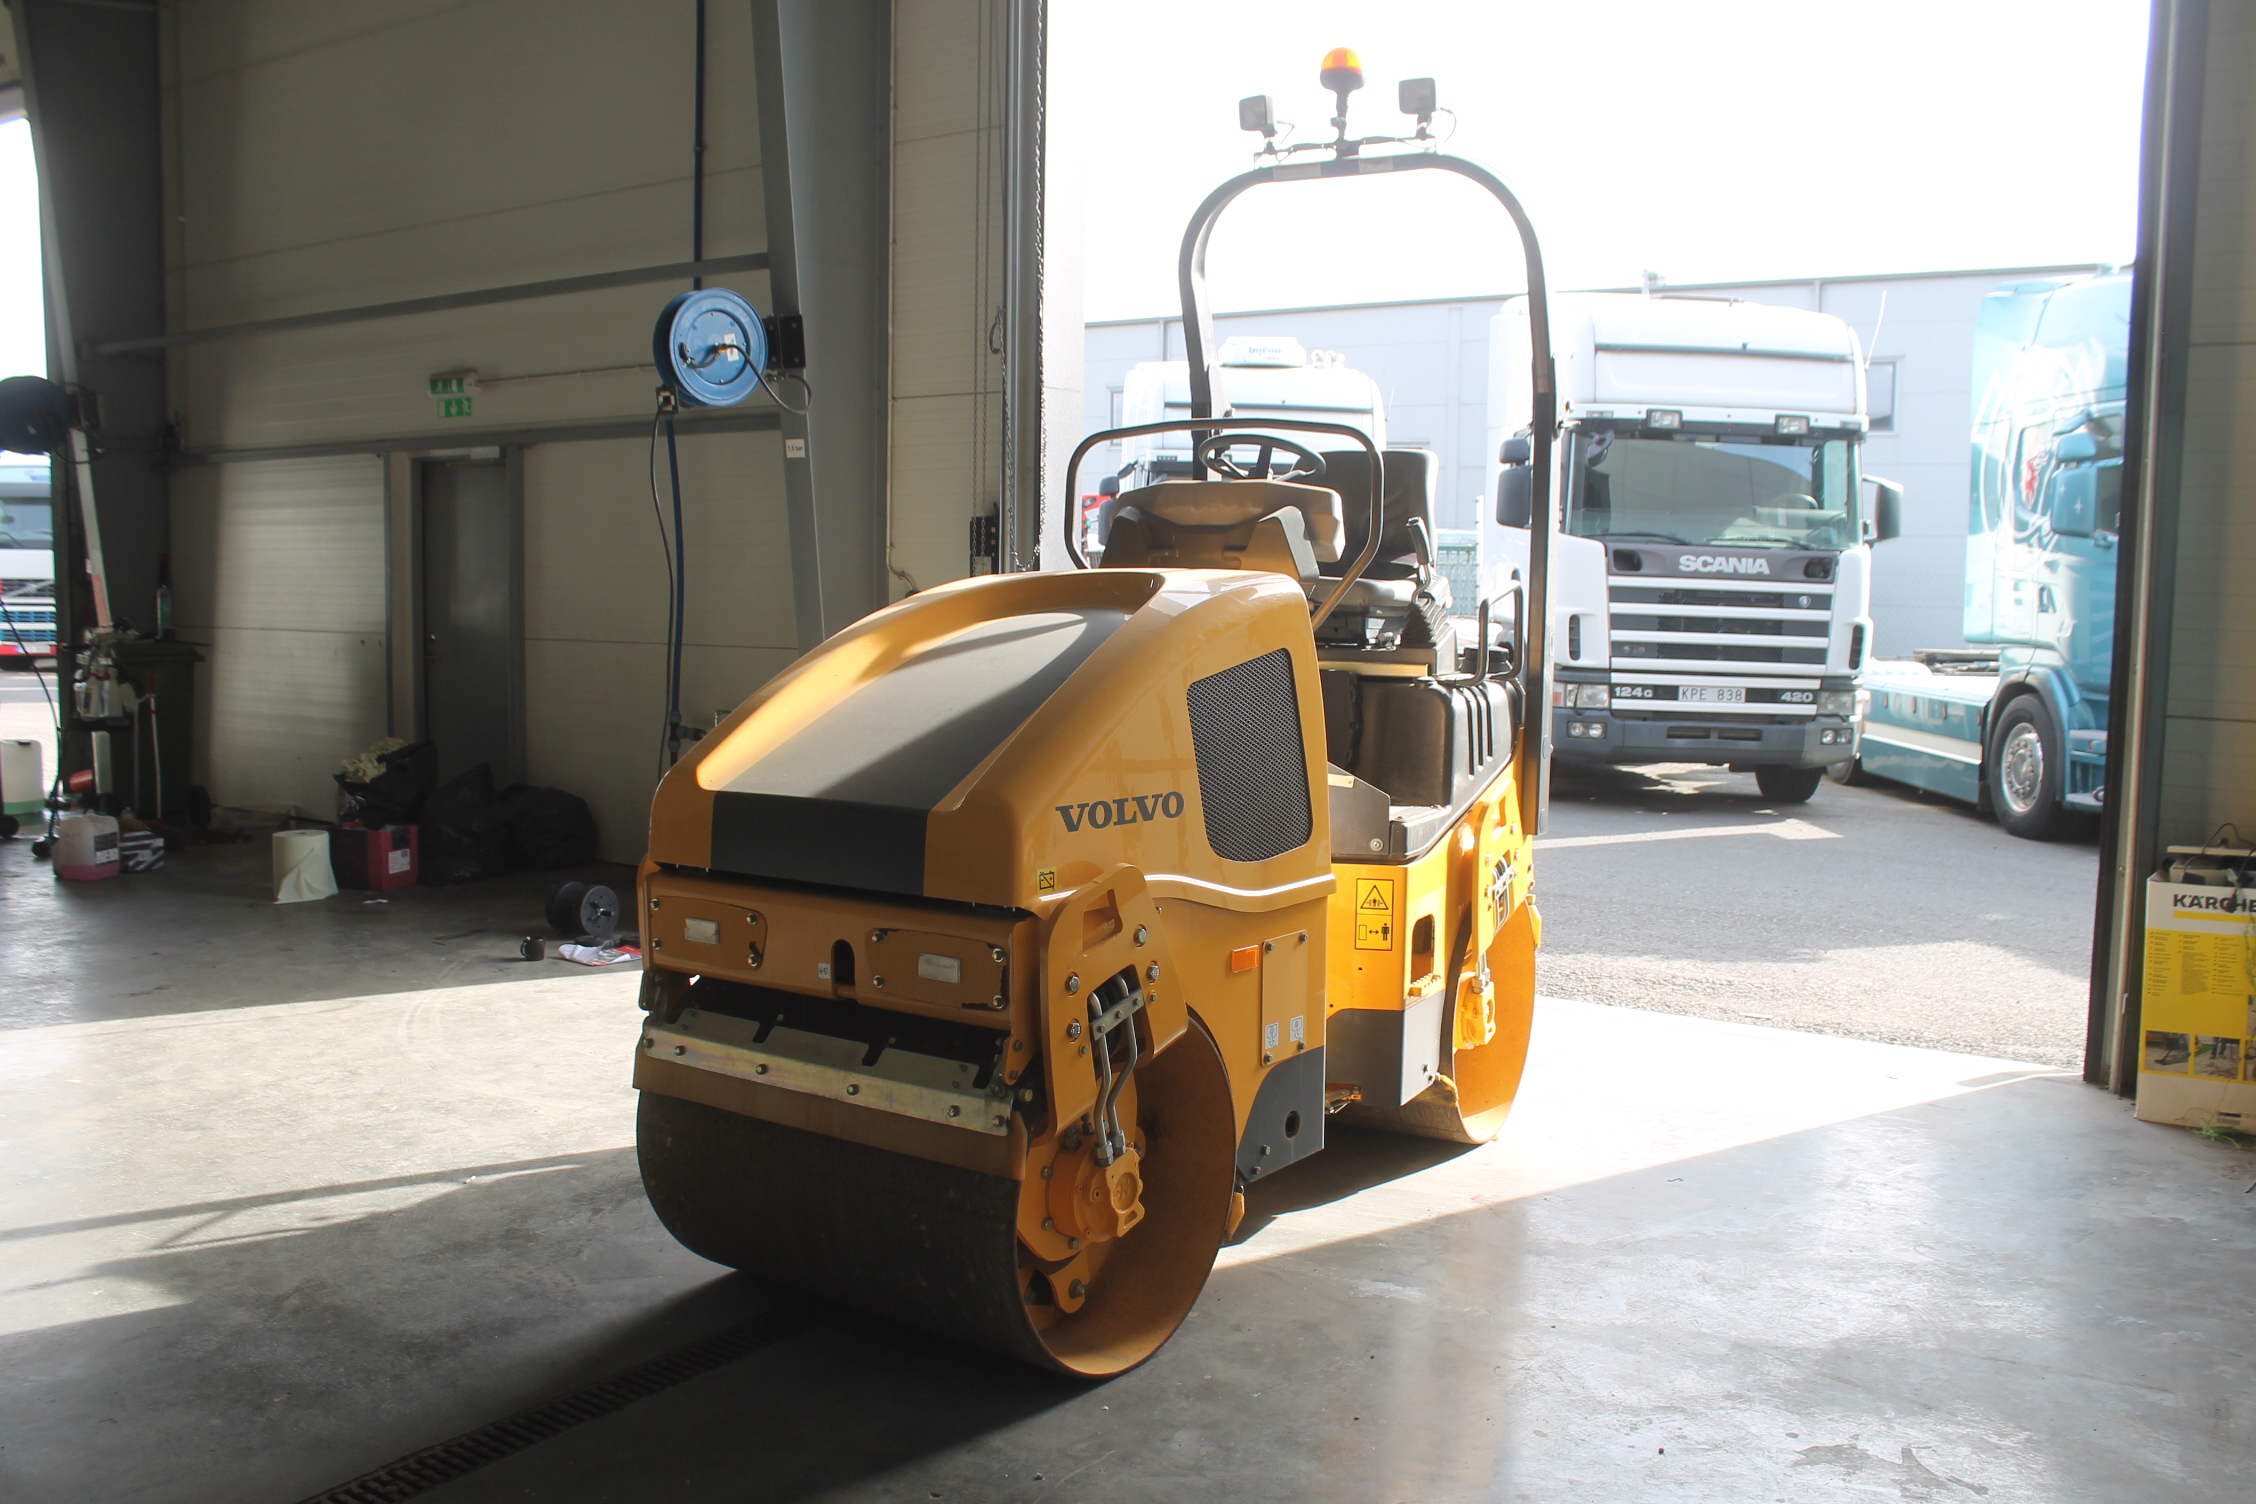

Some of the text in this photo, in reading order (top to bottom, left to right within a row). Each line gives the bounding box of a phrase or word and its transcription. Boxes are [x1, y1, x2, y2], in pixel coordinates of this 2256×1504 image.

[1678, 554, 1771, 575] SCANIA
[1614, 686, 1653, 698] 124G
[1681, 688, 1743, 702] KPE 838
[1781, 691, 1813, 703] 420
[1055, 791, 1185, 833] VOLVO
